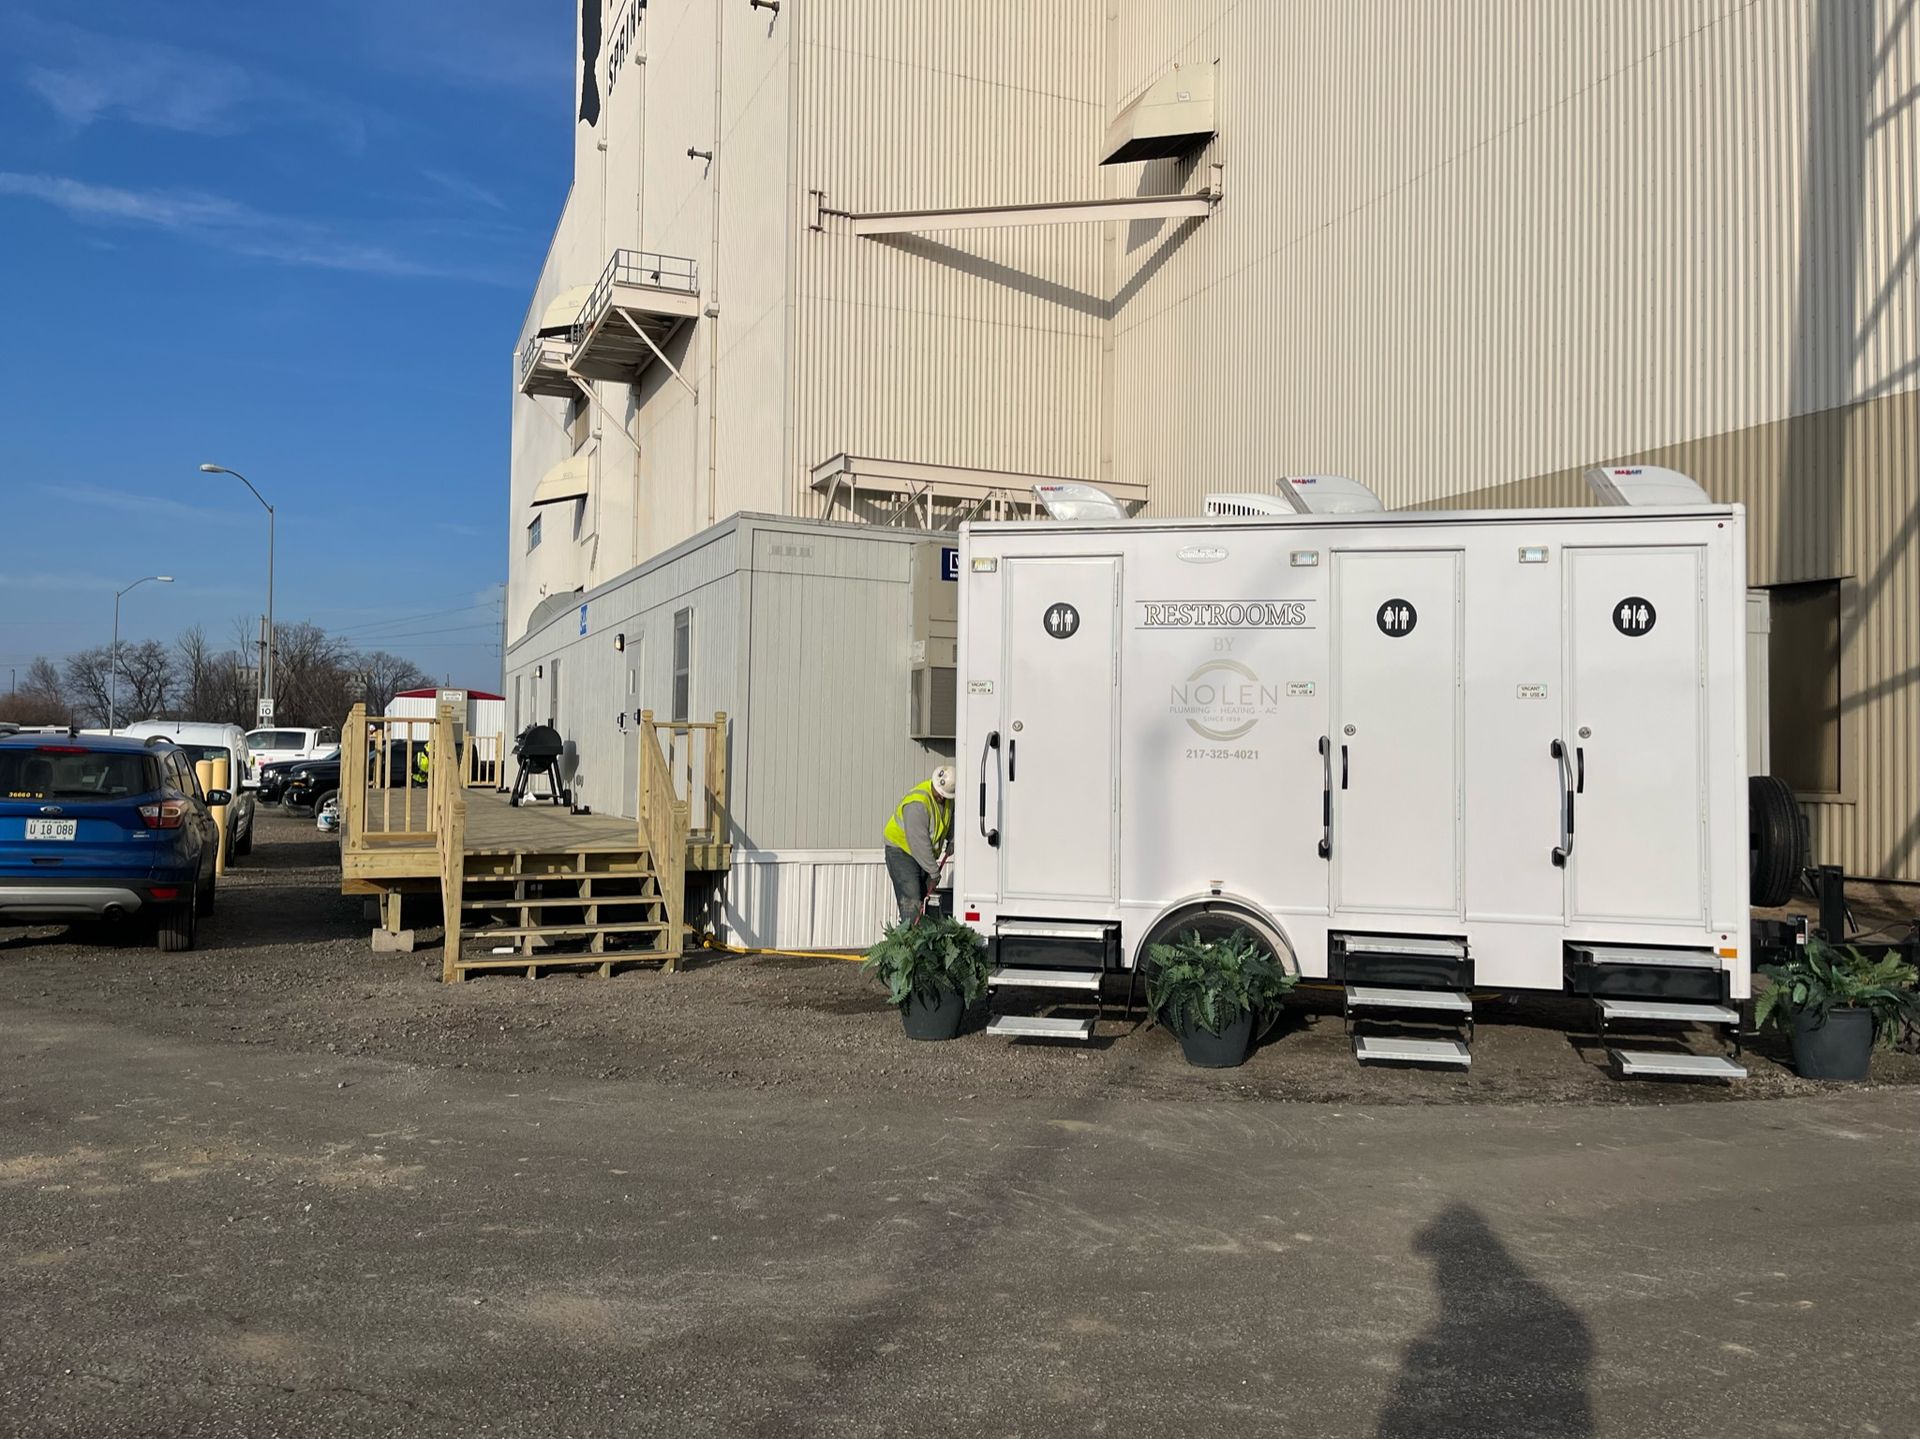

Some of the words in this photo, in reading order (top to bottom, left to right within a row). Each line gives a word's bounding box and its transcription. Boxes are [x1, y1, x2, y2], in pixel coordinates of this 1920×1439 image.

[1143, 602, 1307, 626] RESTROOMS
[1212, 636, 1236, 652] BY
[1169, 684, 1279, 706] NOLEN
[261, 707, 272, 715] 10
[1169, 706, 1211, 714] PLUMBING
[1186, 748, 1260, 760] 217-325-4021
[29, 824, 37, 835] U
[40, 824, 53, 836] 18
[56, 824, 74, 836] 088
